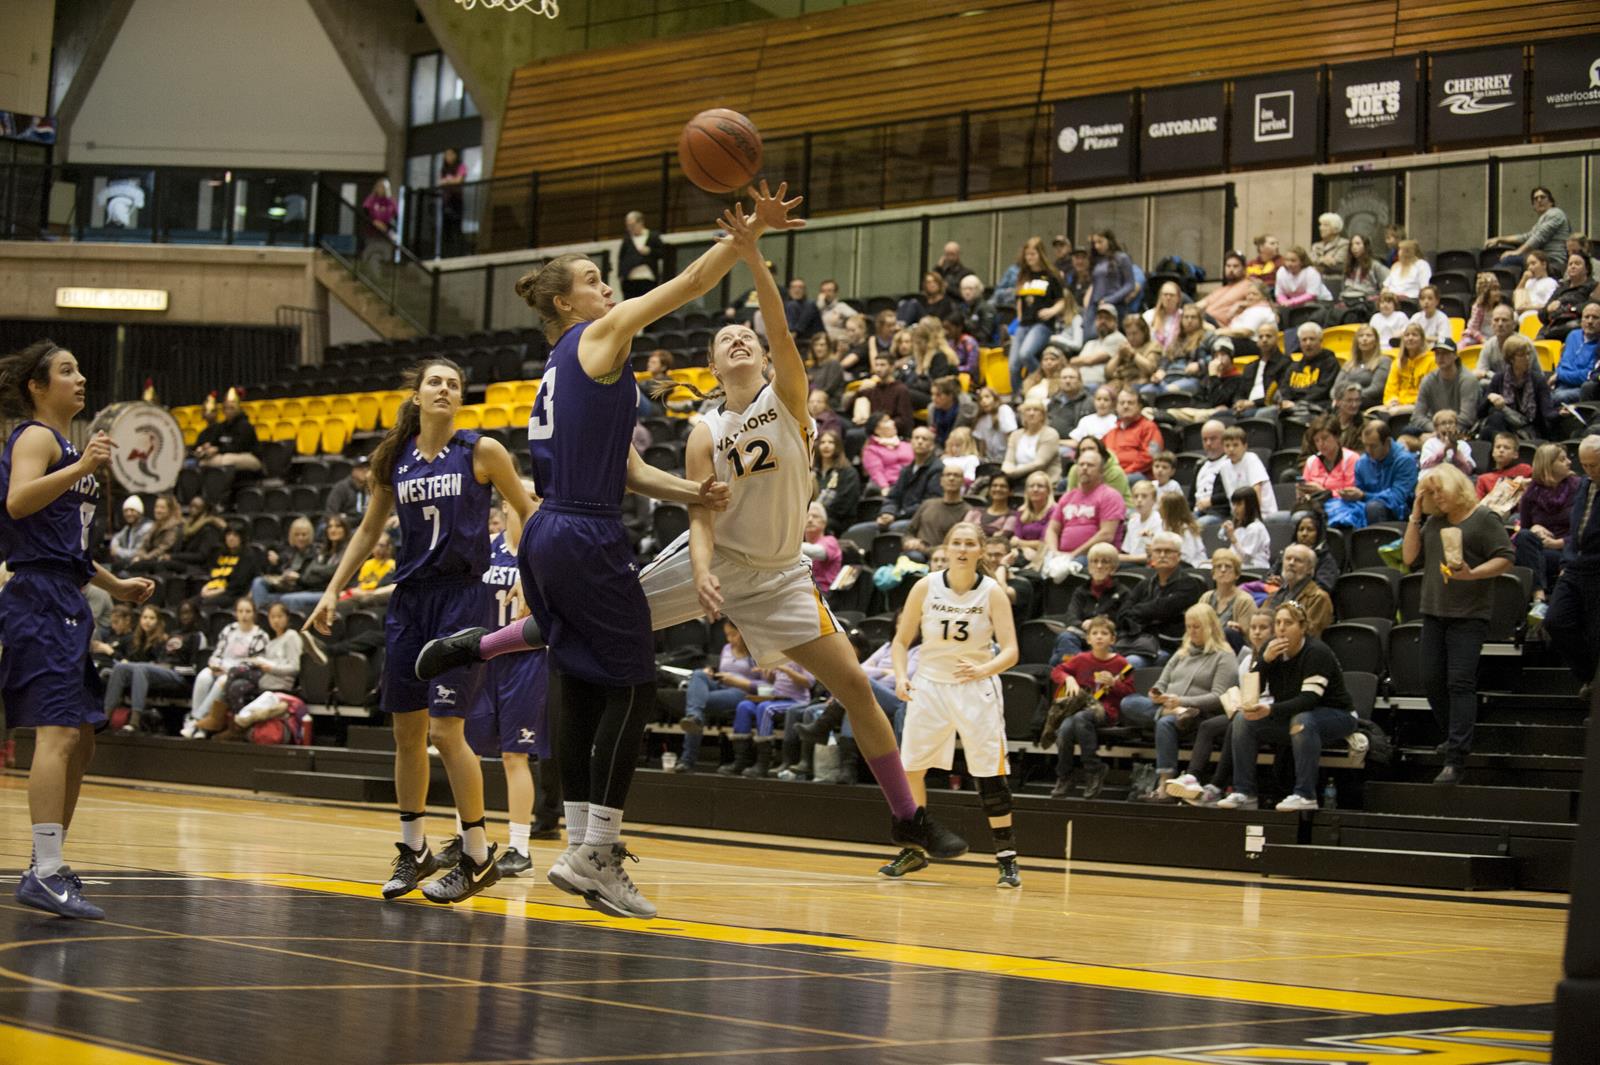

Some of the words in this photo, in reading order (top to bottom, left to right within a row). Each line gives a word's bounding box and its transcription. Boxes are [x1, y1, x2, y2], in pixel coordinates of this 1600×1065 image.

[1444, 74, 1512, 95] CHERREY
[1346, 93, 1400, 118] JOE'S
[1149, 116, 1217, 138] GATORADE
[727, 438, 777, 478] 12
[397, 473, 462, 505] WESTERN
[421, 505, 440, 551] 7
[940, 620, 969, 642] 13
